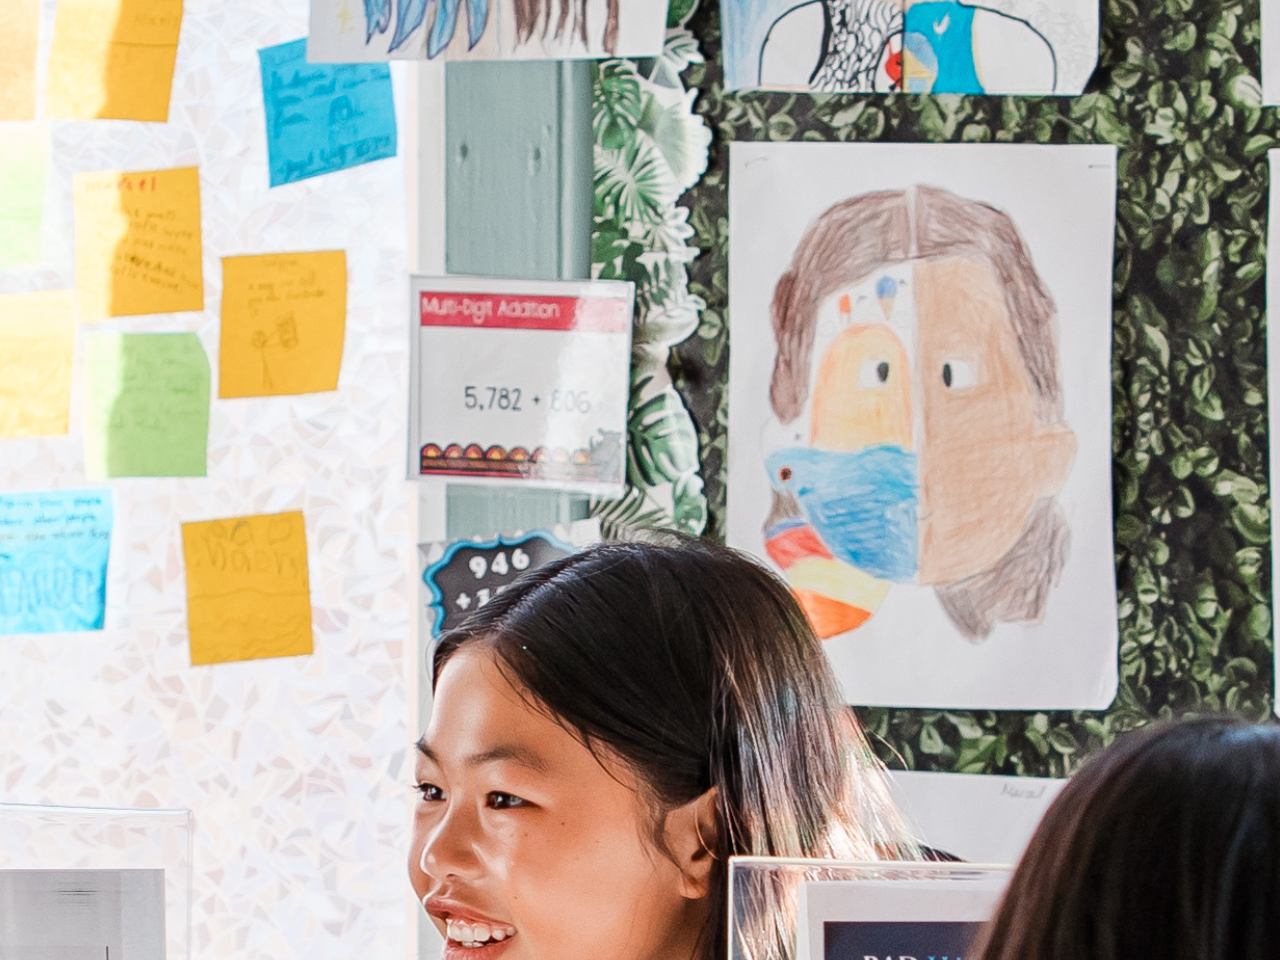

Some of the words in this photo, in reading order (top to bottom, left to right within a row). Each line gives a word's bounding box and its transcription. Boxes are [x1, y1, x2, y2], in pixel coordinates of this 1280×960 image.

[421, 297, 493, 324] Multi-Digit
[497, 299, 561, 318] Addition
[464, 385, 523, 411] 5,782
[531, 394, 541, 406] +
[468, 547, 531, 580] 946
